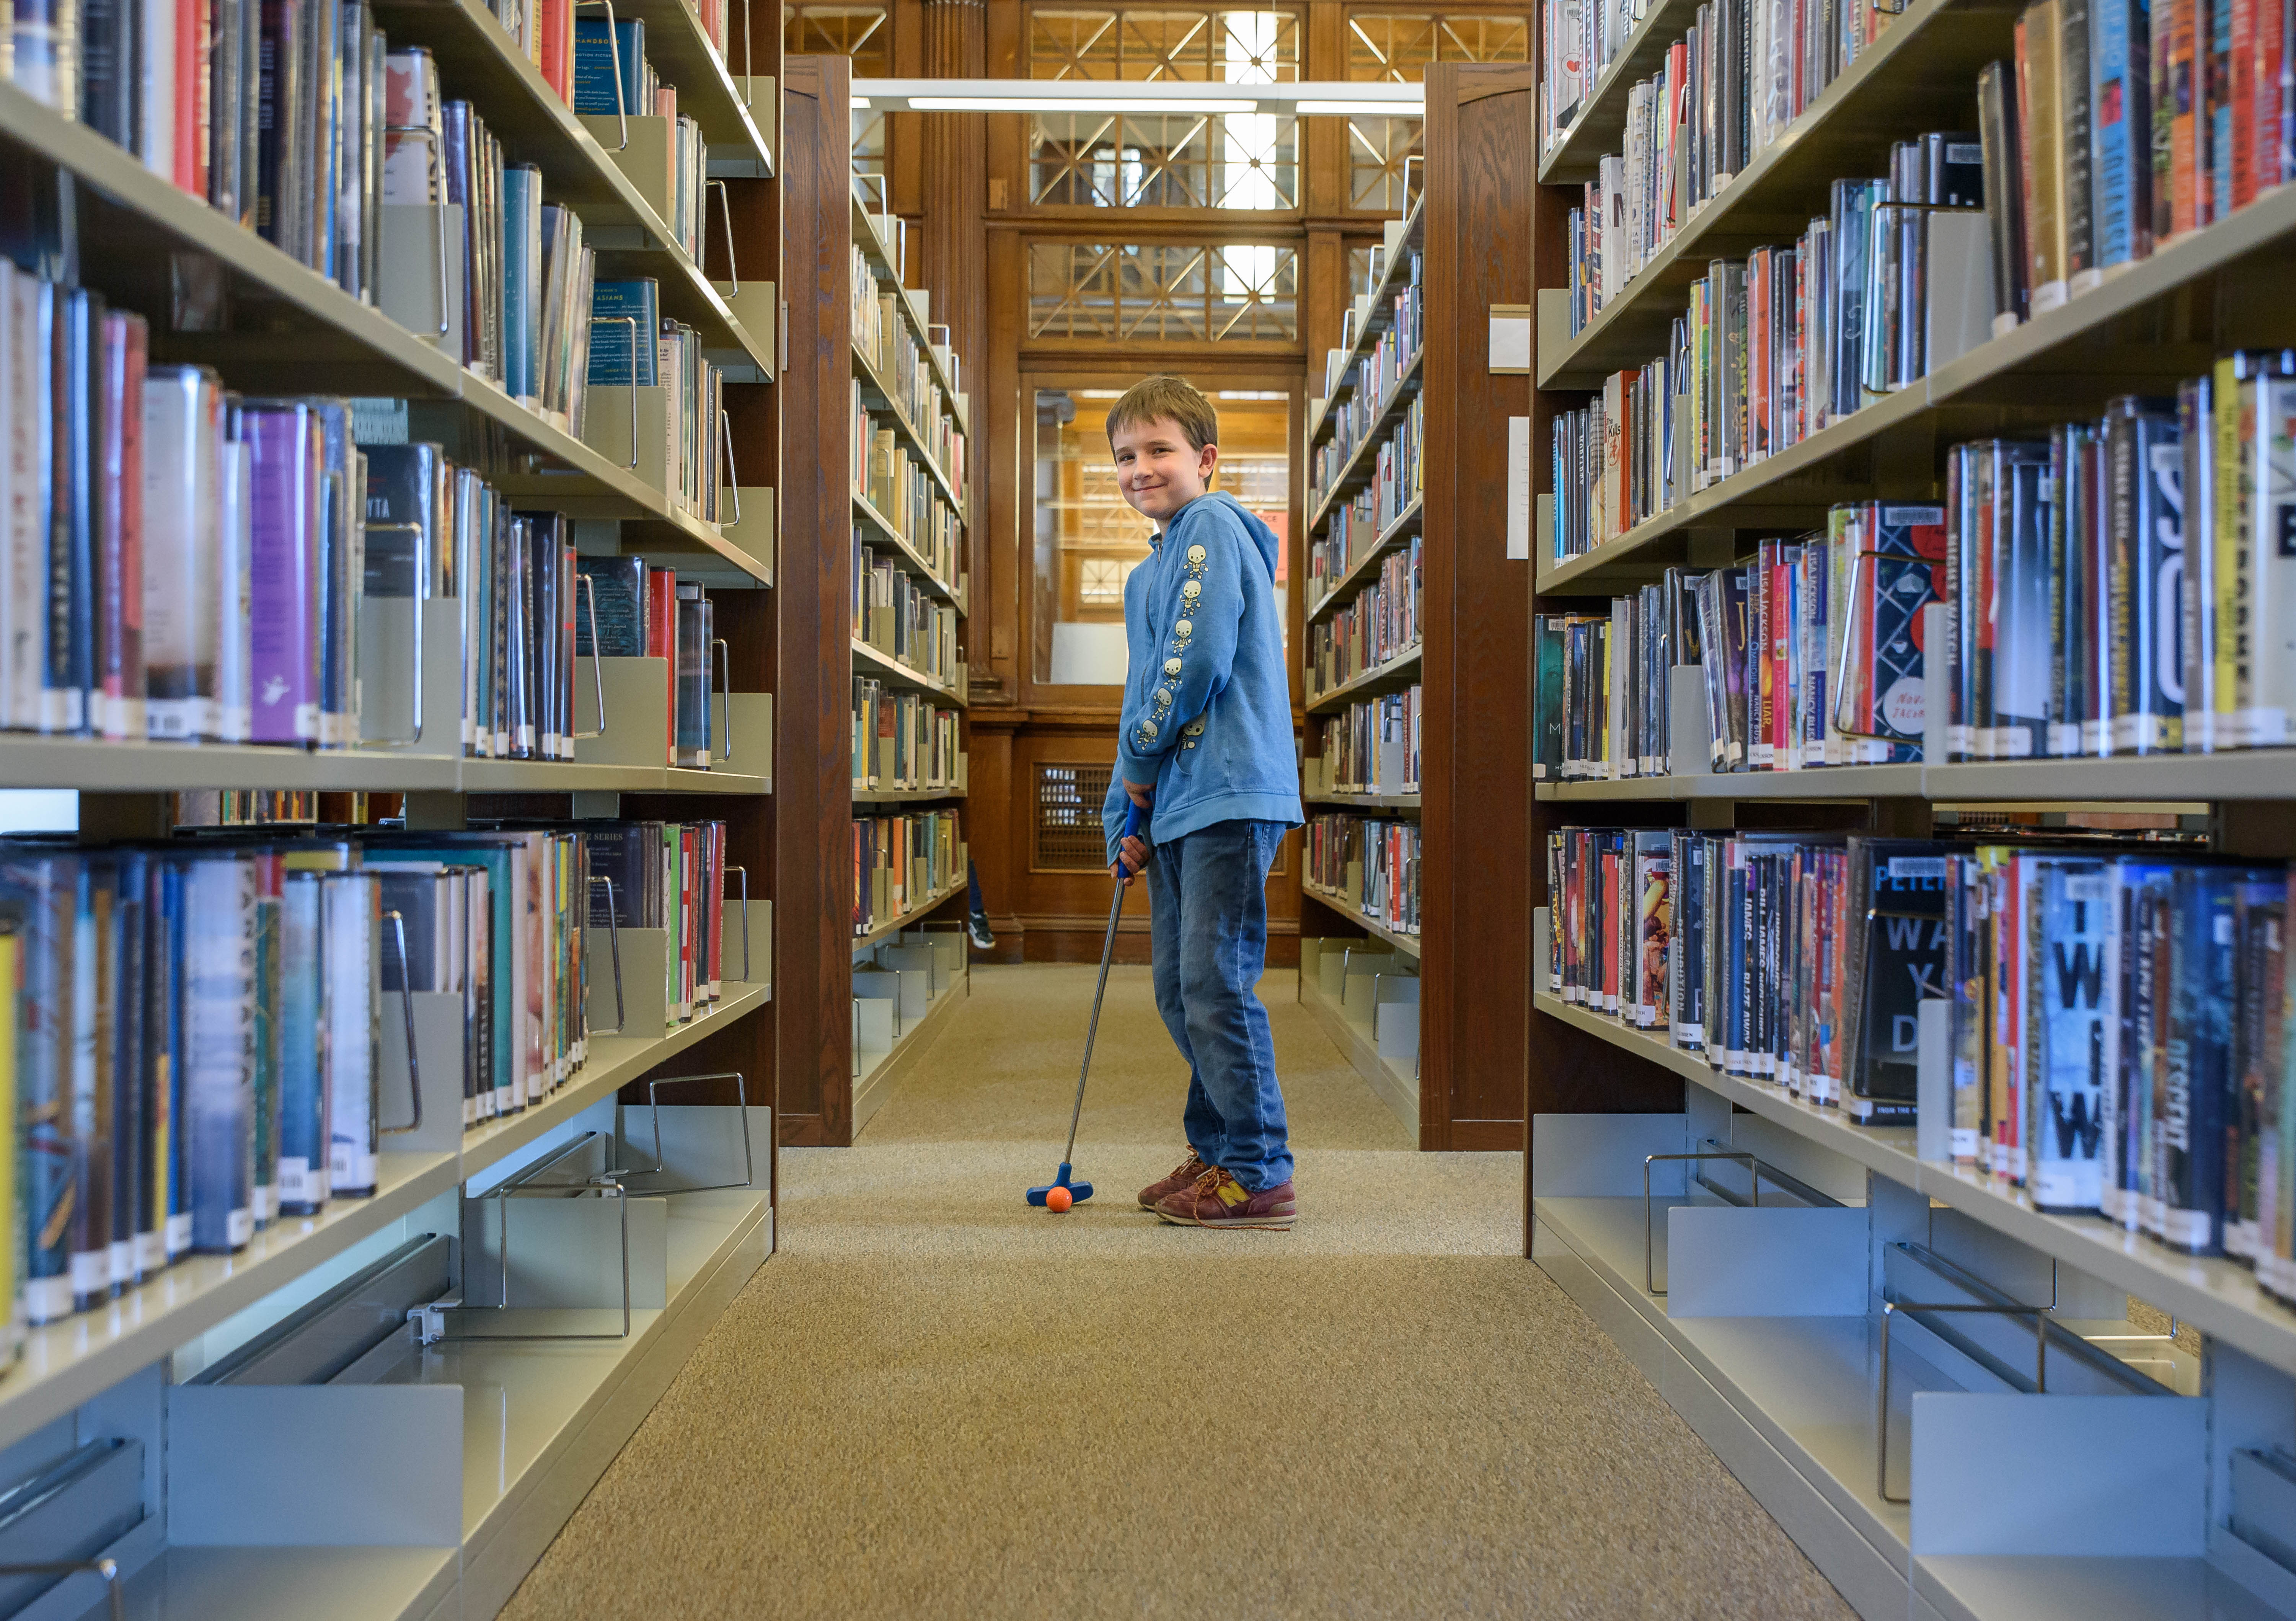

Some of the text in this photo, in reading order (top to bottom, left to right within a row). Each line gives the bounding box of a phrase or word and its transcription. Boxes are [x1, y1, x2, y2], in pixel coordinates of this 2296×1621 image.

[1608, 423, 1621, 439] Kills
[1761, 571, 1769, 651] LISA JACKSON
[594, 833, 623, 841] SERIES
